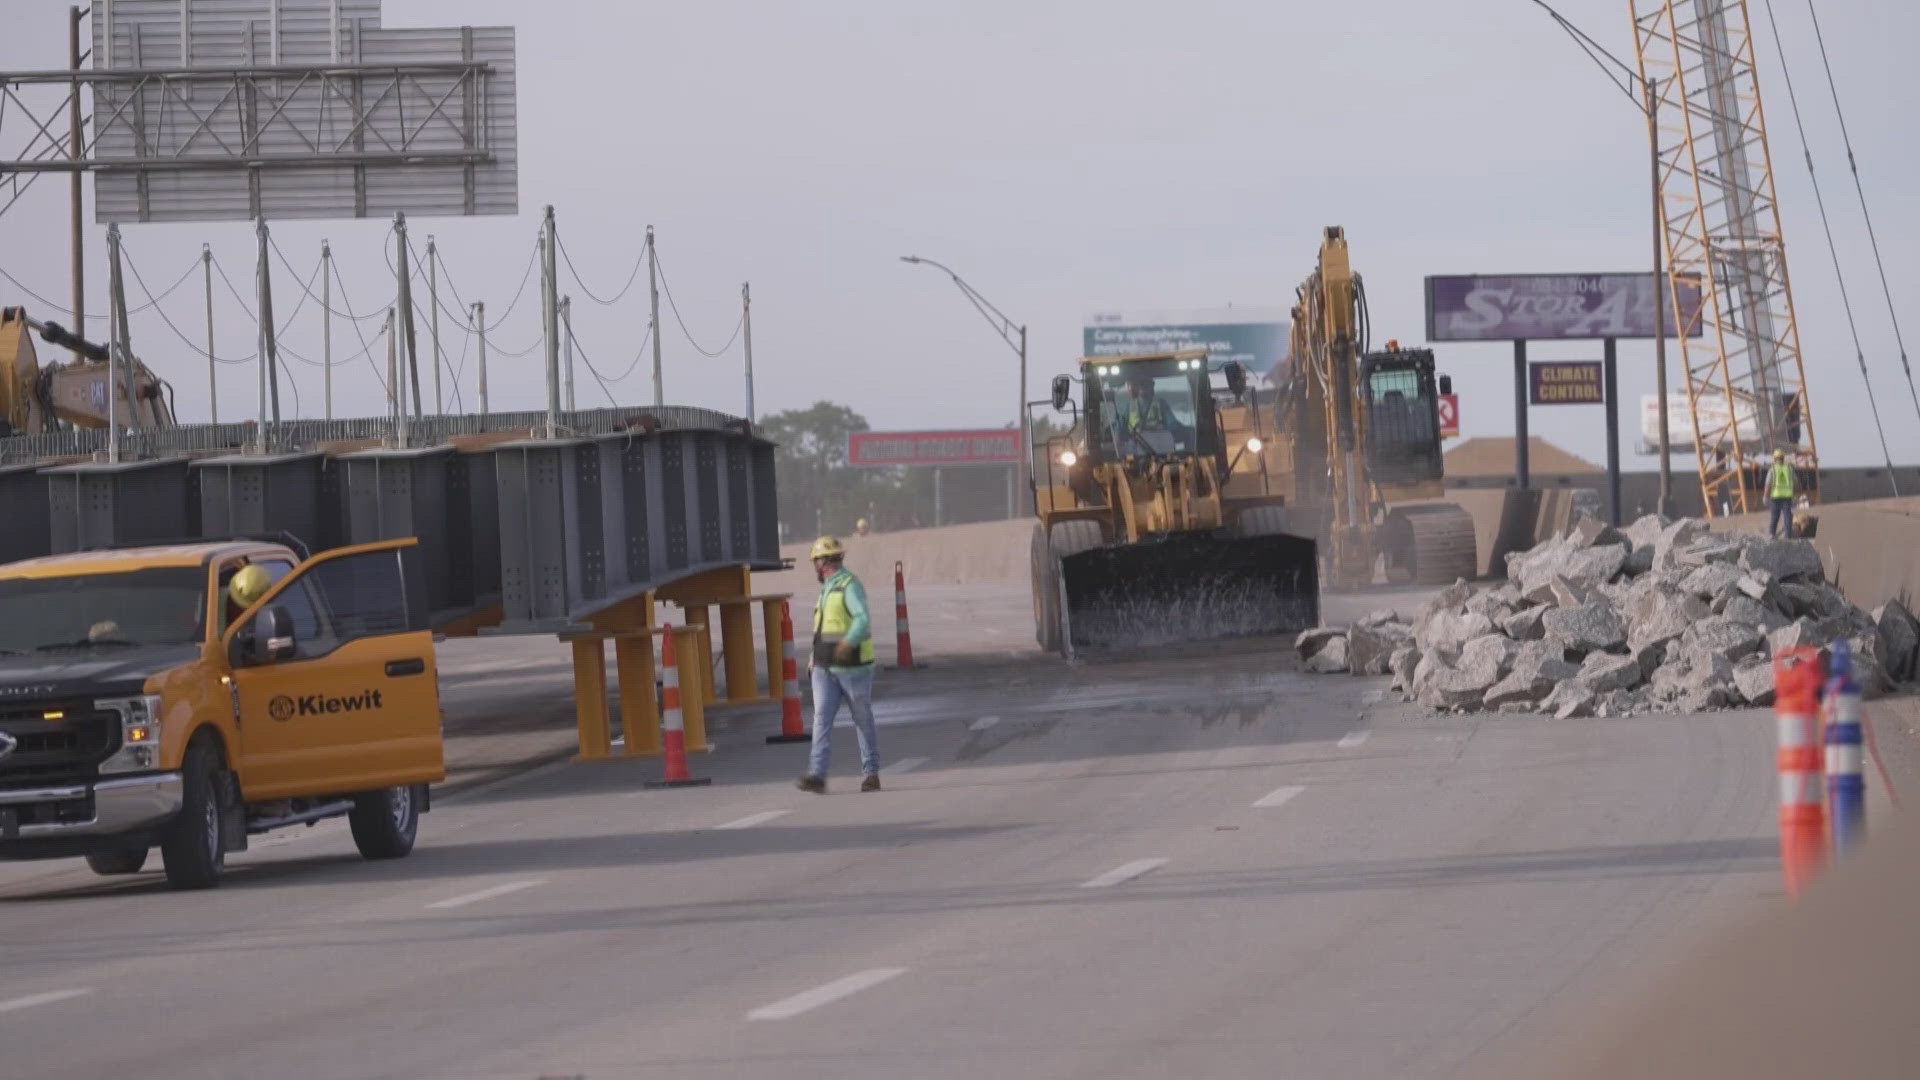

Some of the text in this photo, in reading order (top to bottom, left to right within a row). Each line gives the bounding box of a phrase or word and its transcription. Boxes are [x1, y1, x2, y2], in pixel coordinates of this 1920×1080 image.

[1541, 366, 1597, 381] CLIMATE
[1539, 383, 1600, 401] CONTROL
[298, 689, 382, 716] Kiewit
